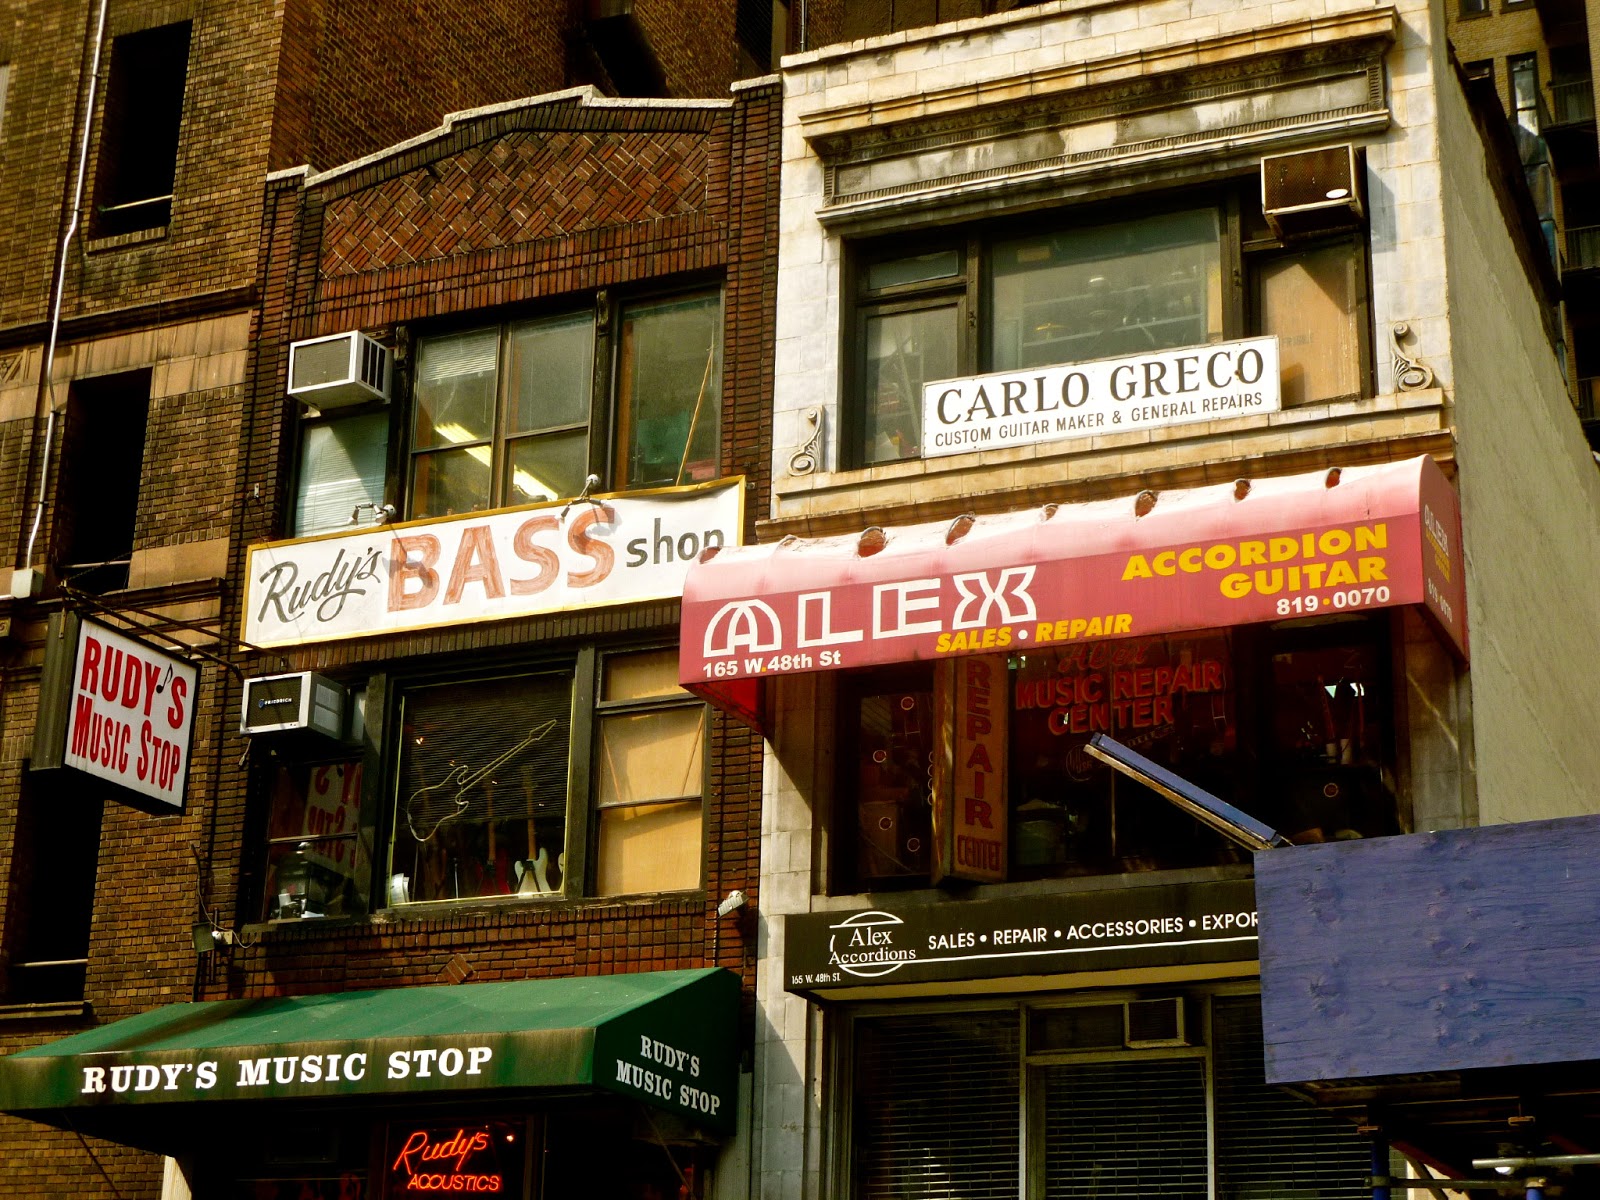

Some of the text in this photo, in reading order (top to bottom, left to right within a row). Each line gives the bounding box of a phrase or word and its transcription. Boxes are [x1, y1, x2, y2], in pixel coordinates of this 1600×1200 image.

[937, 348, 1264, 425] CARLO GRECO
[935, 392, 1263, 447] CUSTOM GUITAR MAKER & GENERAL REPAIRS
[257, 546, 382, 623] Rudy's
[386, 507, 615, 613] BASS
[1120, 523, 1388, 581] ACCORDION
[1219, 556, 1388, 599] GUITAR
[703, 565, 1038, 659] ALEX
[936, 613, 1133, 653] SALES REPAIR
[703, 660, 738, 678] 165
[819, 650, 841, 666] St
[1016, 661, 1222, 710] MUSIC REPAIR
[1048, 697, 1174, 736] CENTER
[71, 694, 181, 791] MUSIC STOP
[965, 659, 993, 829] REPAIR
[828, 947, 916, 965] Accordions
[849, 926, 893, 946] Alex
[928, 932, 975, 950] SALES
[993, 928, 1047, 946] REPAIR
[1067, 917, 1183, 940] ACCESSORIES
[792, 975, 803, 985] 165
[815, 973, 830, 983] 48th
[81, 1046, 493, 1094] RUDY'S MUSIC STOP
[640, 1034, 700, 1077] RUDY'S
[616, 1059, 720, 1115] MUSIC STOP
[393, 1129, 489, 1175] Rudy's
[407, 1174, 500, 1191] ACOUSTICS
